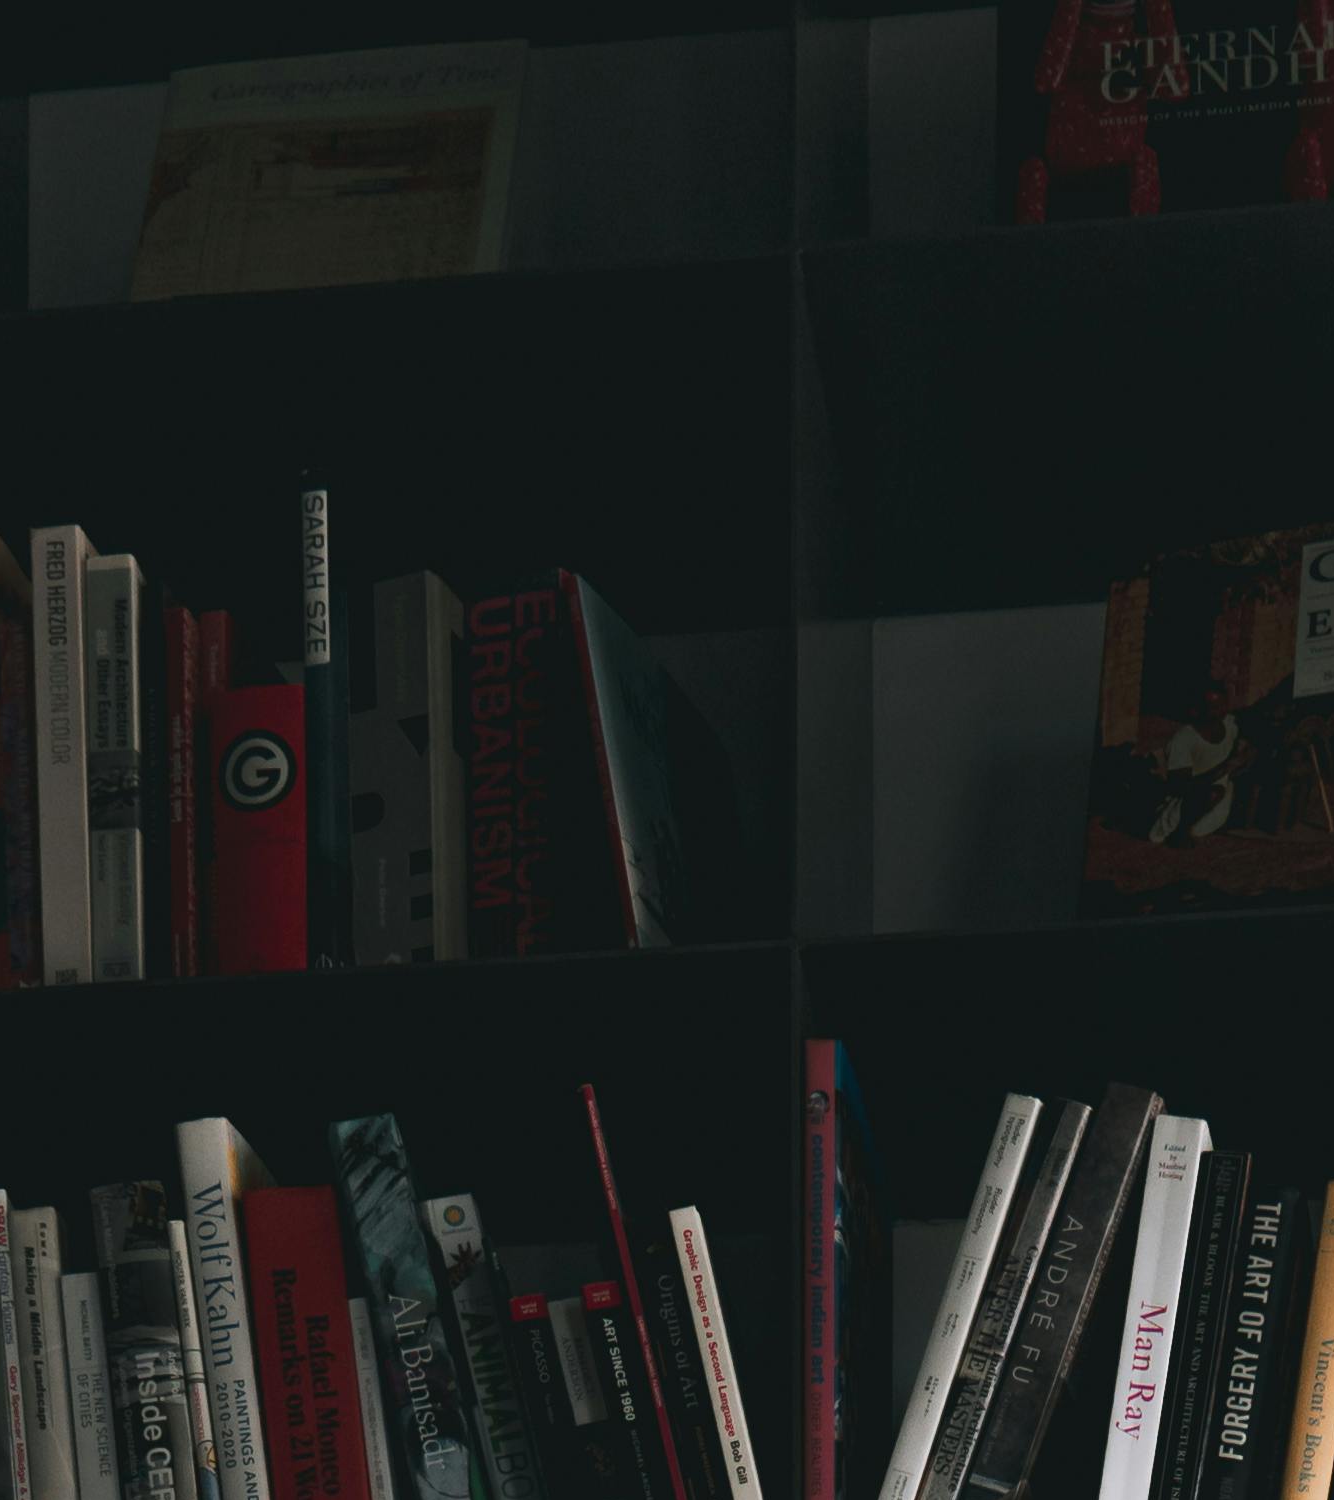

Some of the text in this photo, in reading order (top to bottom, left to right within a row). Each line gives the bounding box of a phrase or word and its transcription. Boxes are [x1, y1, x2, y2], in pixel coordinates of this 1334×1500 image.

[305, 495, 325, 655] SARAH SZE
[46, 540, 70, 765] FRED HERZOG MODERN COLOR
[191, 1181, 239, 1368] Wolf Kahn
[682, 1230, 702, 1270] Graphic
[272, 1268, 307, 1386] Remarks
[692, 1275, 711, 1311] Design
[703, 1316, 712, 1328] as
[1010, 1216, 1084, 1385] ANDRÉ FU
[1217, 1202, 1282, 1462] THE ART OF FORGERY
[387, 1294, 455, 1470] Ali Banisadr
[708, 1342, 727, 1382] Second
[1116, 1301, 1167, 1441] Man Ray
[287, 1395, 304, 1428] on
[305, 1315, 341, 1495] Rafael Moneo
[715, 1386, 737, 1437] Language
[291, 1435, 312, 1463] 21
[730, 1441, 742, 1462] Bob
[736, 1465, 748, 1484] Gill
